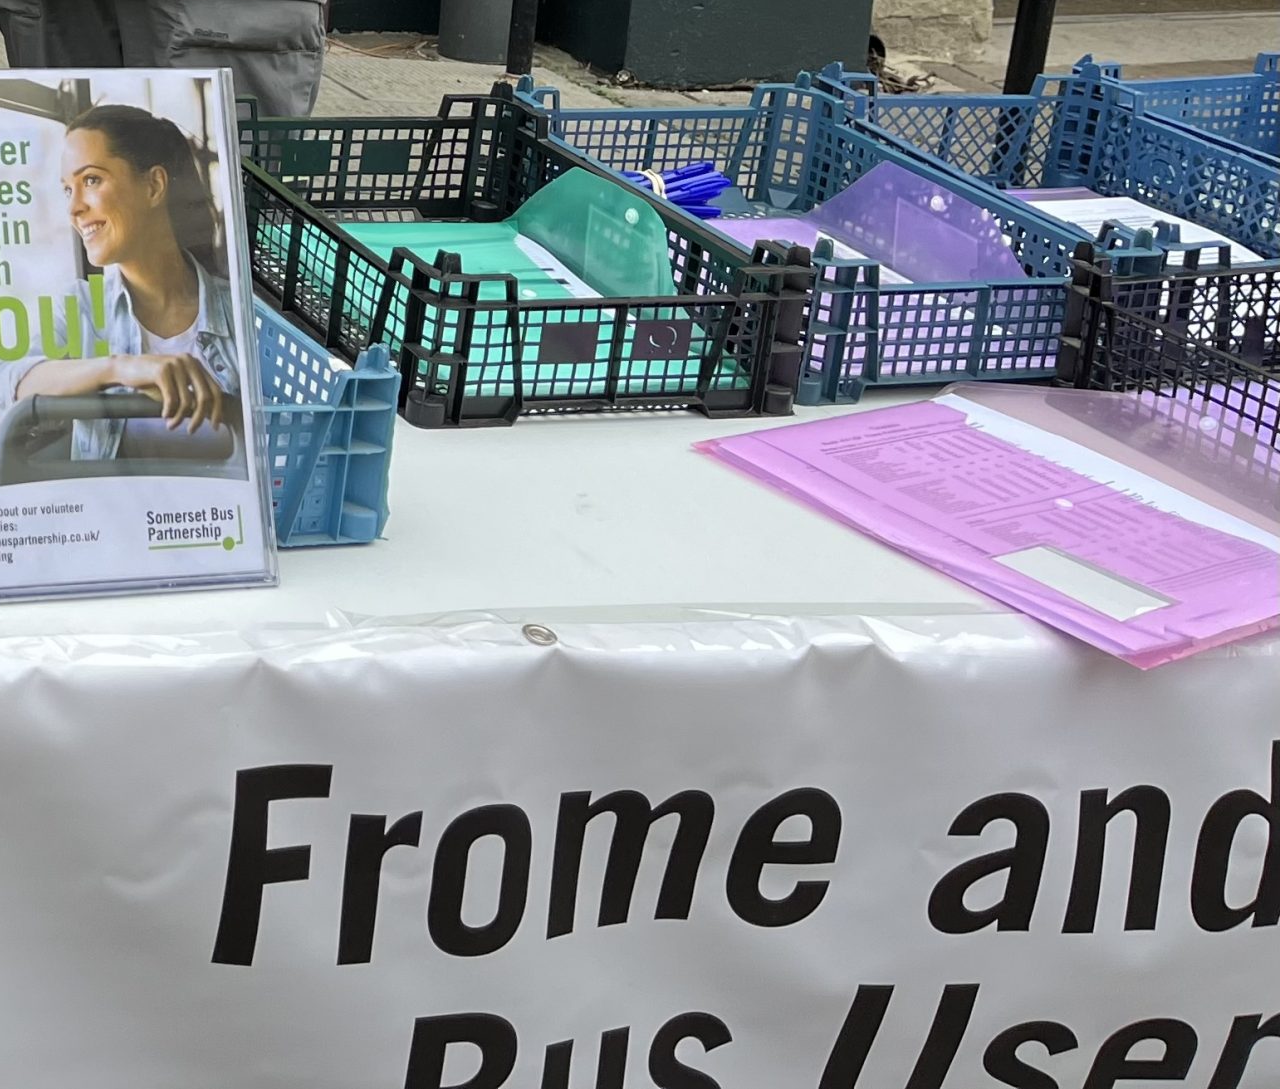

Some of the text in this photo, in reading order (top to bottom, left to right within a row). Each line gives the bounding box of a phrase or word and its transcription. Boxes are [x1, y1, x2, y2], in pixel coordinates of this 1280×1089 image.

[21, 505, 38, 516] our
[40, 503, 84, 514] volunteer
[146, 507, 235, 526] Somerset Bus
[147, 524, 223, 542] Partnership
[210, 740, 1280, 967] Frome and
